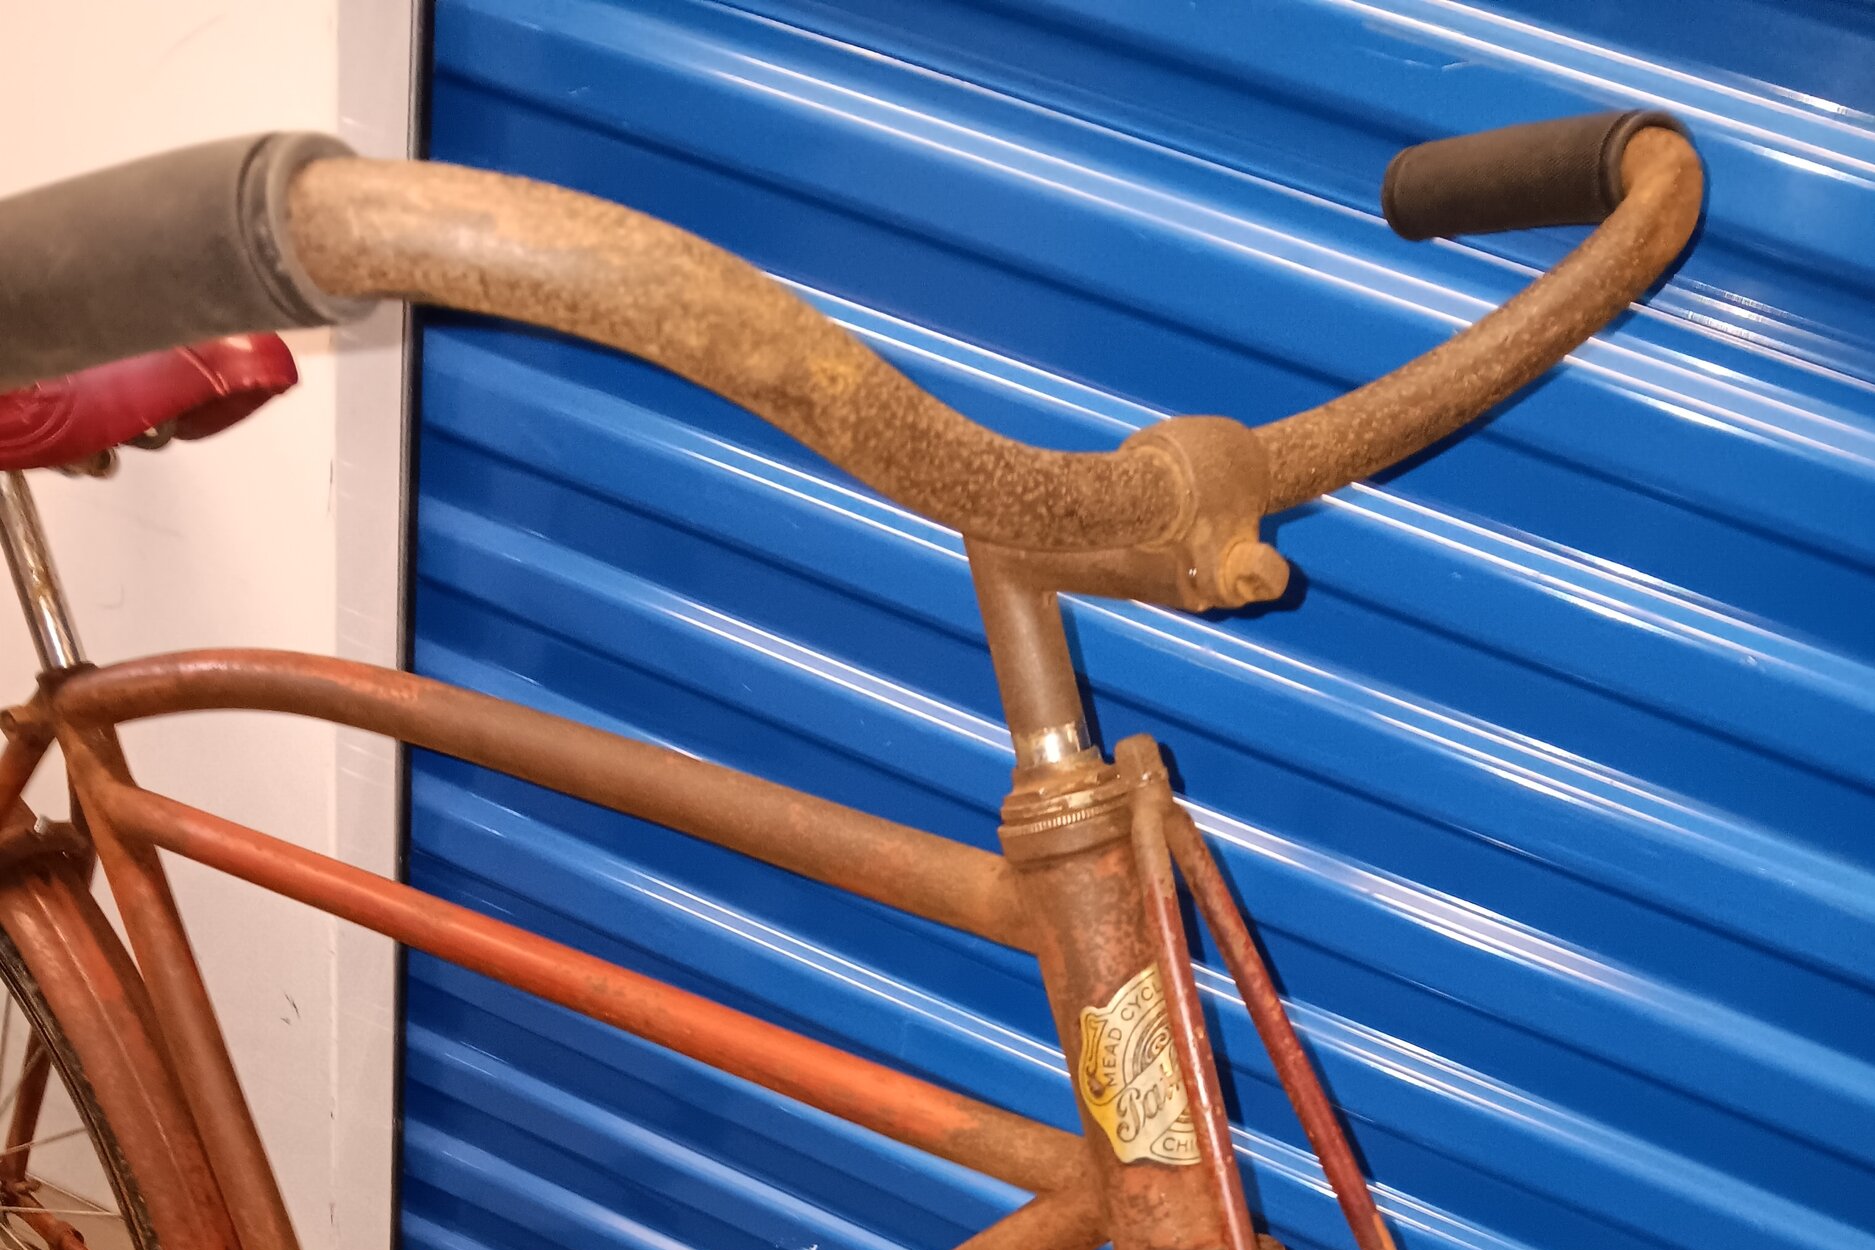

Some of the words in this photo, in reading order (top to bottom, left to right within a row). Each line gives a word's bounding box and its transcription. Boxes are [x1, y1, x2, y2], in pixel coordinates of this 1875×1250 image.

[1102, 1027, 1122, 1087] MEAD
[1120, 982, 1163, 1022] CYCL
[1162, 1136, 1195, 1152] CHI
